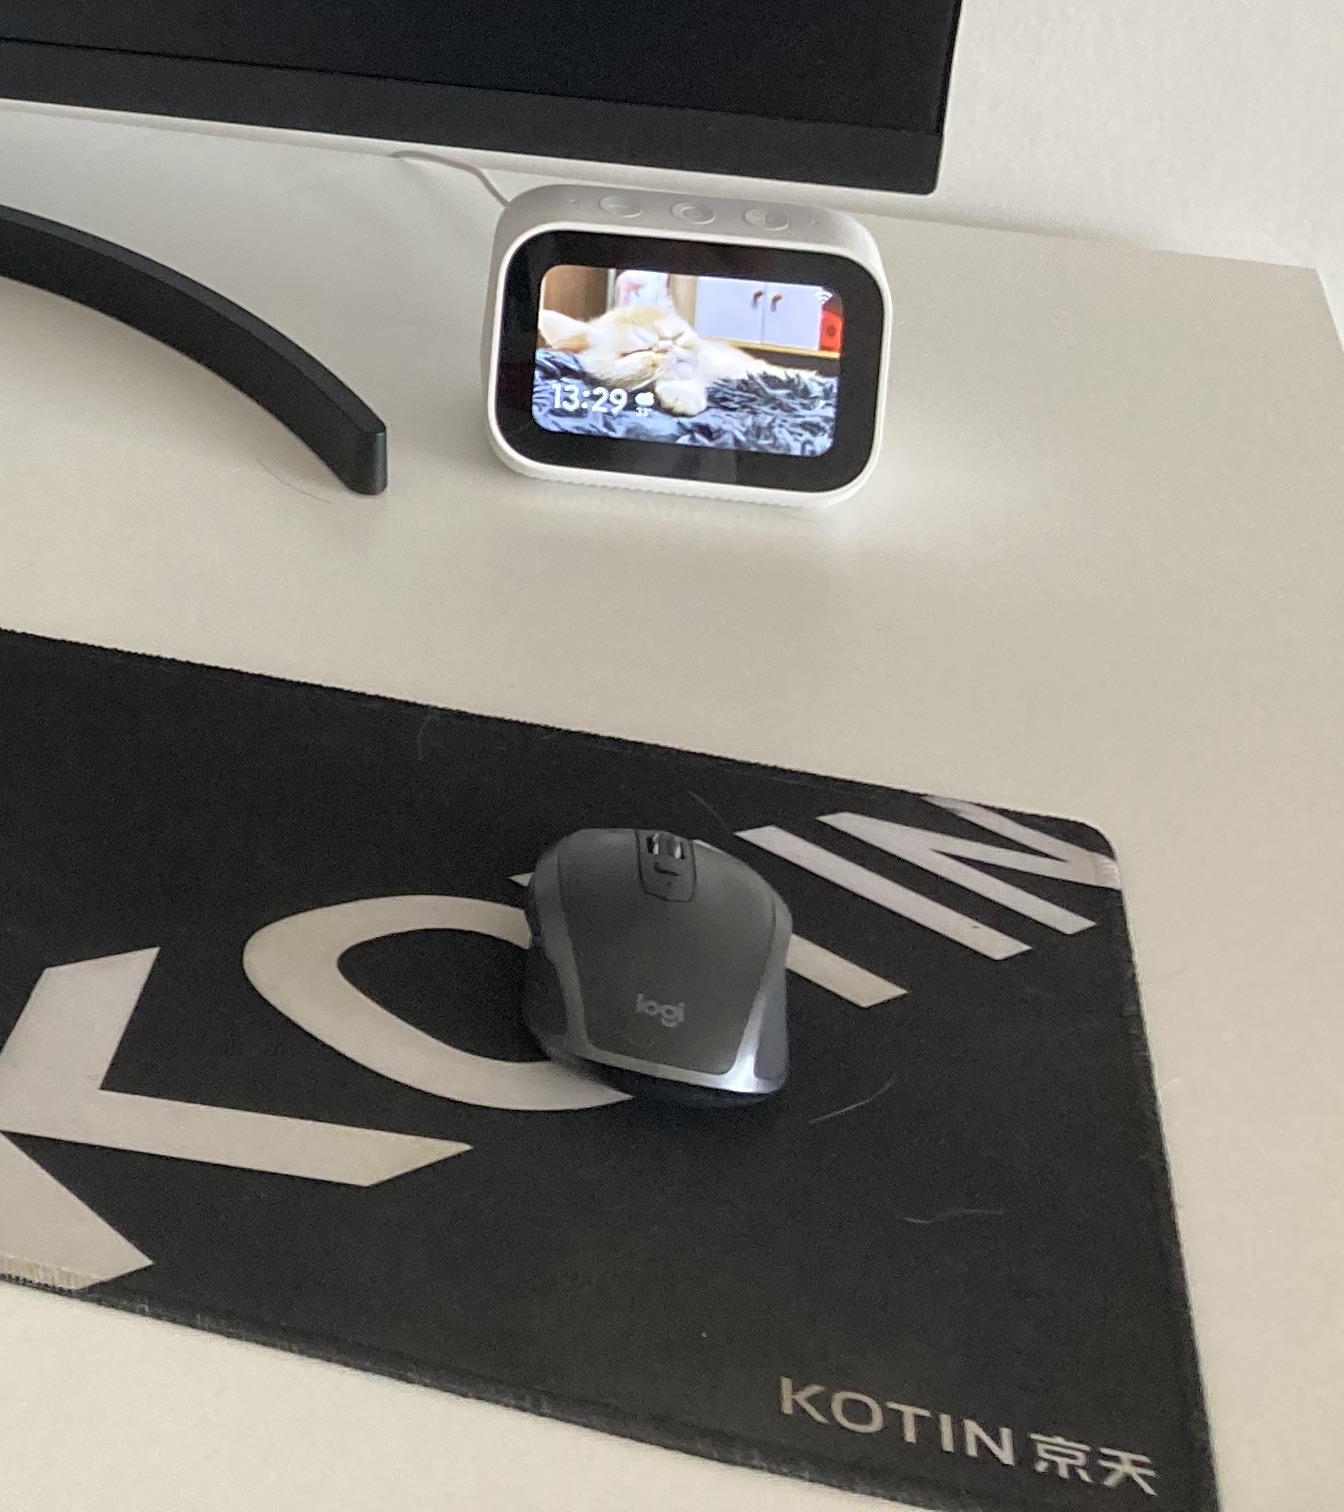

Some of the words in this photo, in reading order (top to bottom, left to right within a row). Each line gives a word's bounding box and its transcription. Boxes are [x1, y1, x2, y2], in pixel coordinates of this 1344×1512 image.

[551, 383, 628, 417] 13:29
[635, 993, 685, 1027] logi
[779, 1376, 1016, 1466] KOTIN
[1028, 1432, 1158, 1496] 京天
